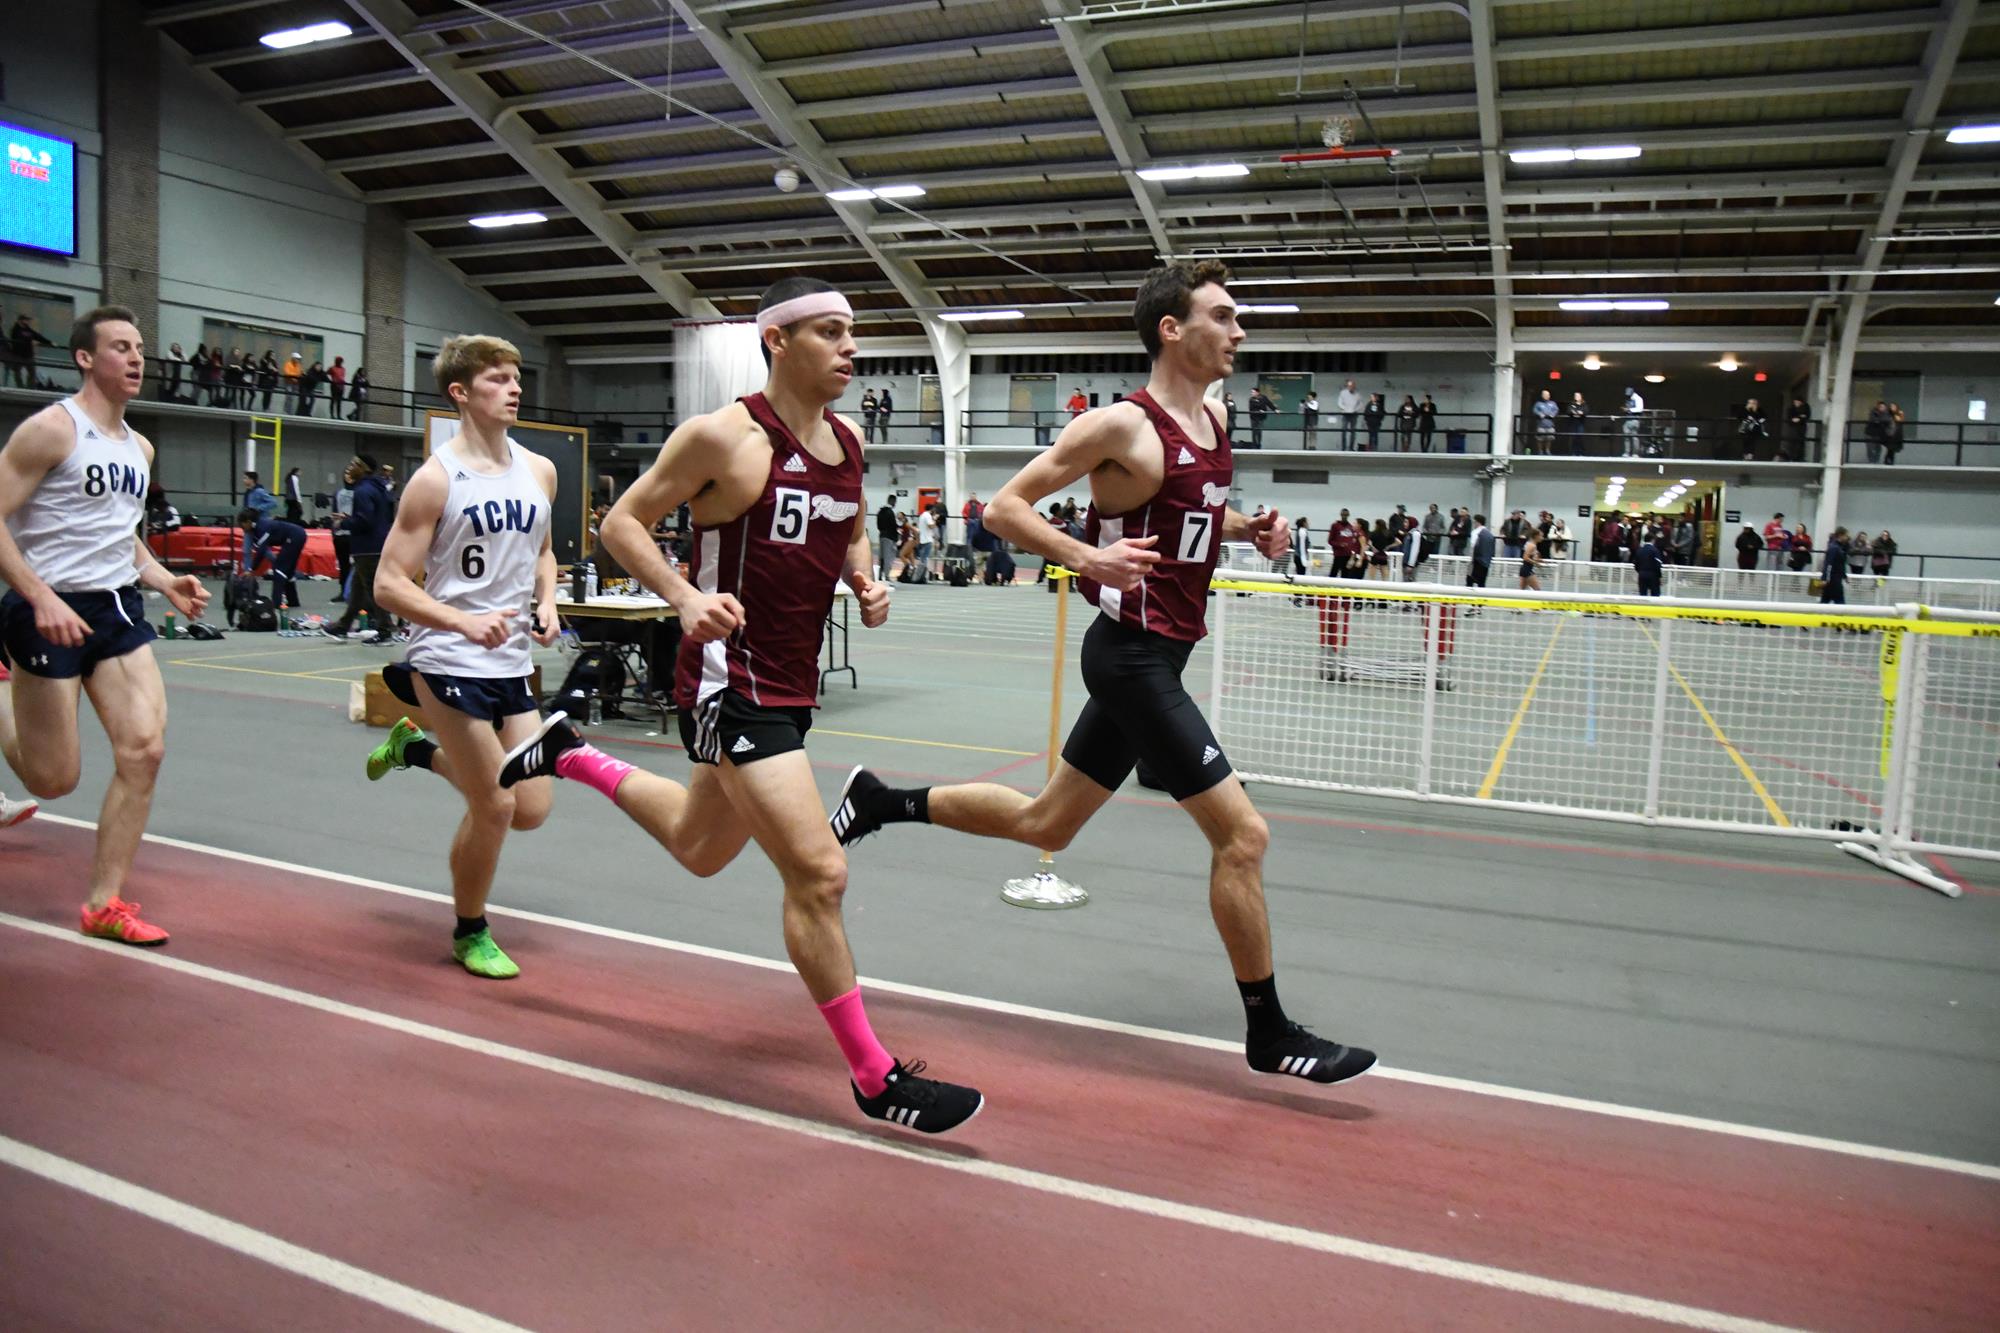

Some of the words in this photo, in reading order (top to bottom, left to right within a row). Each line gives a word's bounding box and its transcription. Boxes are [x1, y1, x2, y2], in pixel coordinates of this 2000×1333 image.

[85, 464, 106, 497] 8
[108, 462, 144, 499] CNJ
[462, 499, 536, 537] TCNJ
[777, 494, 802, 539] 5
[1187, 516, 1208, 559] 7
[461, 544, 485, 579] 6
